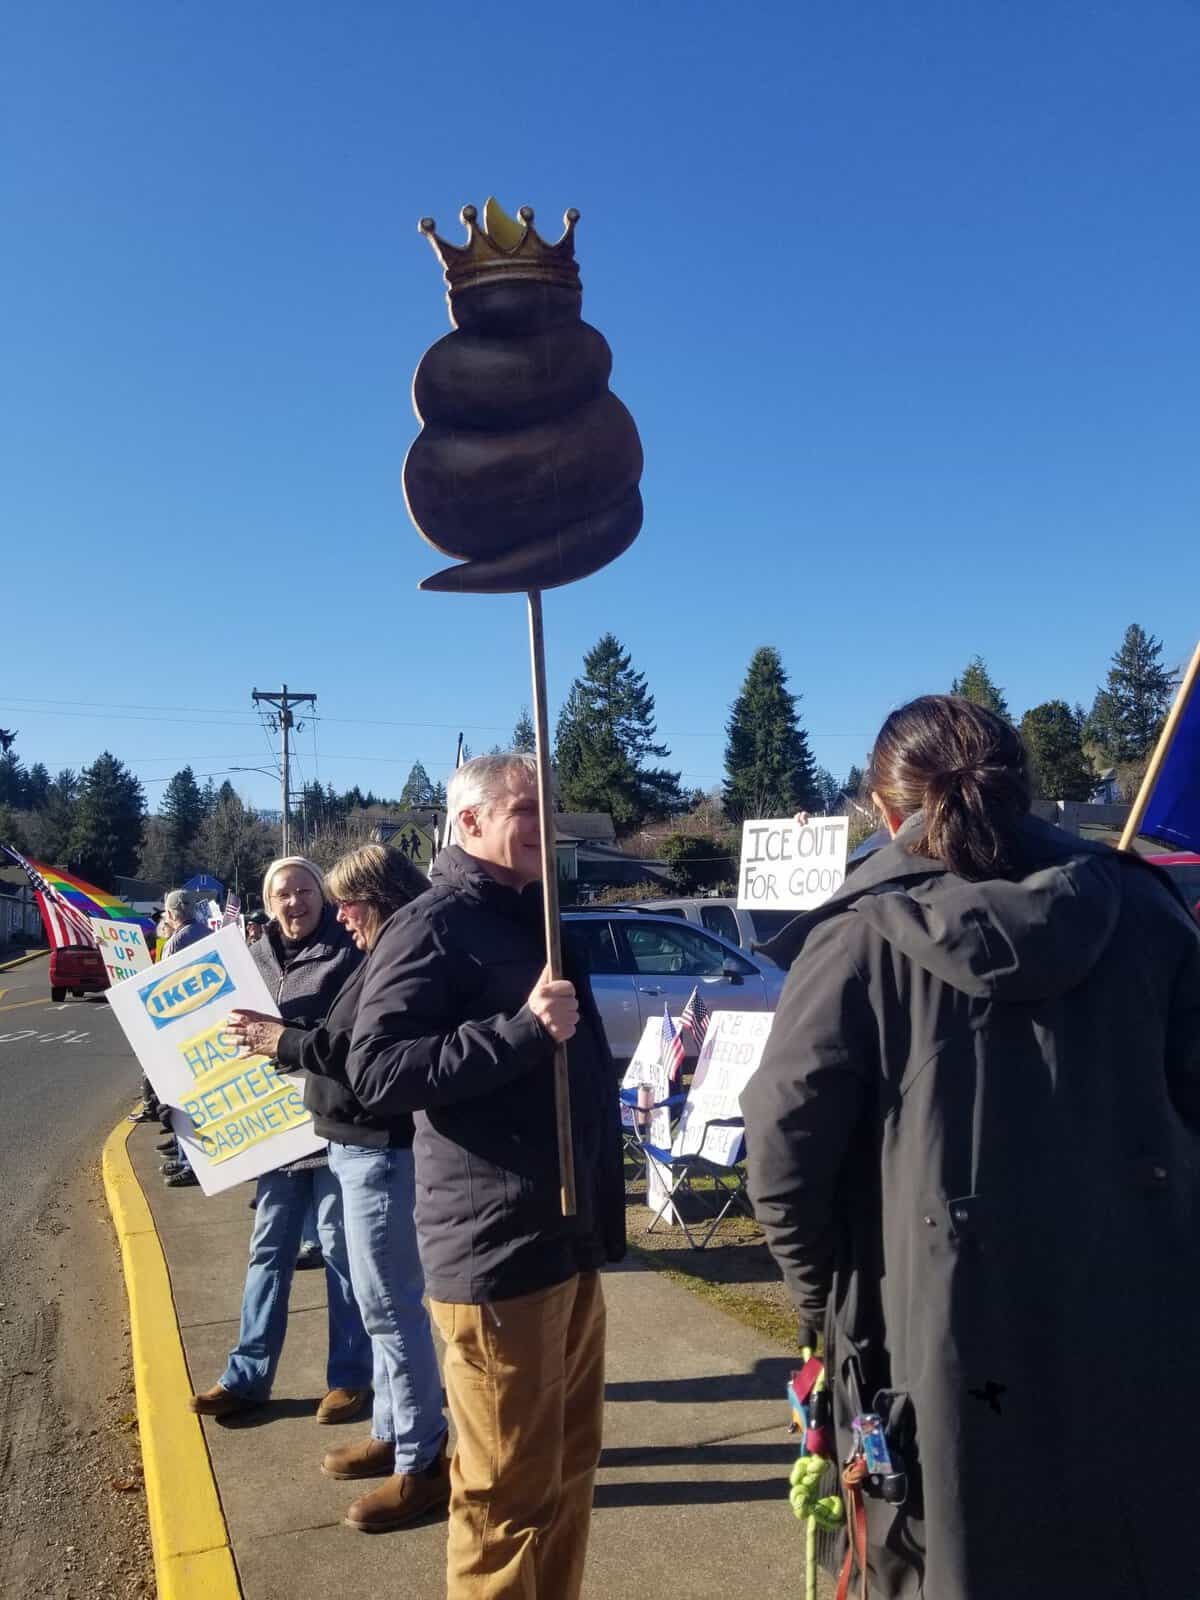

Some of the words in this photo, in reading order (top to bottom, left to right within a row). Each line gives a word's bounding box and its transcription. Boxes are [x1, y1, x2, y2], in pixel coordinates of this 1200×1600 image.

[746, 827, 793, 863] ICE
[797, 824, 845, 858] OUT
[744, 866, 779, 900] FOR
[788, 867, 842, 896] GOOD
[100, 926, 141, 945] LOCK
[114, 945, 134, 961] UP
[152, 967, 223, 1013] IKEA
[184, 1031, 241, 1078] HAS
[184, 1062, 287, 1129] BETTER
[201, 1092, 307, 1157] CABINETS
